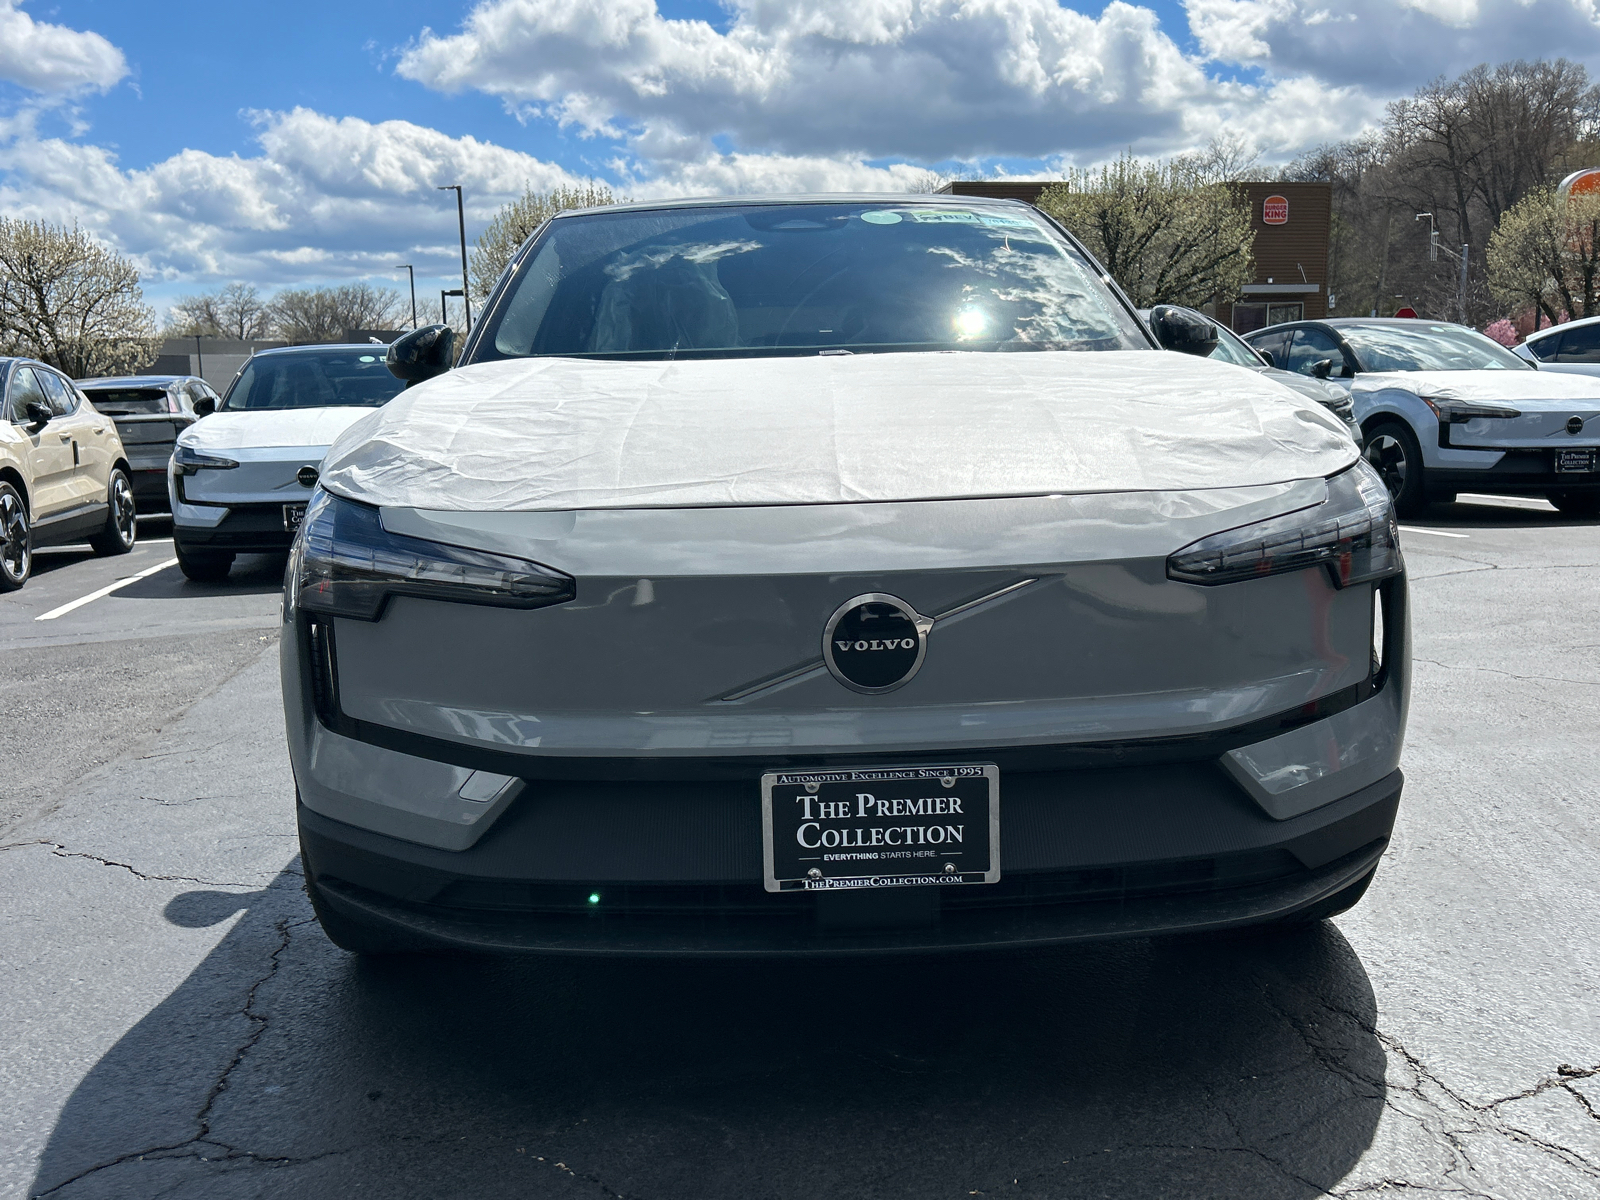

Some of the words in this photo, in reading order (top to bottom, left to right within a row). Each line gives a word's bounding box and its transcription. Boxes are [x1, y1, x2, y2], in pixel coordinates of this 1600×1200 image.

[1265, 210, 1287, 218] KING
[835, 638, 915, 651] VOLVO
[779, 772, 848, 783] AUTOMOTIVE
[852, 769, 916, 780] EXCELLENCE
[918, 768, 950, 778] SINCE
[953, 767, 982, 776] 1995
[796, 795, 851, 820] THE
[856, 793, 964, 817] PREMIER
[796, 822, 965, 849] COLLECTION
[823, 852, 879, 861] EVERYTHING
[880, 851, 911, 859] STARTS
[913, 850, 938, 858] HERE.
[802, 875, 963, 890] THEPREMIERCOLLECTION.COM
